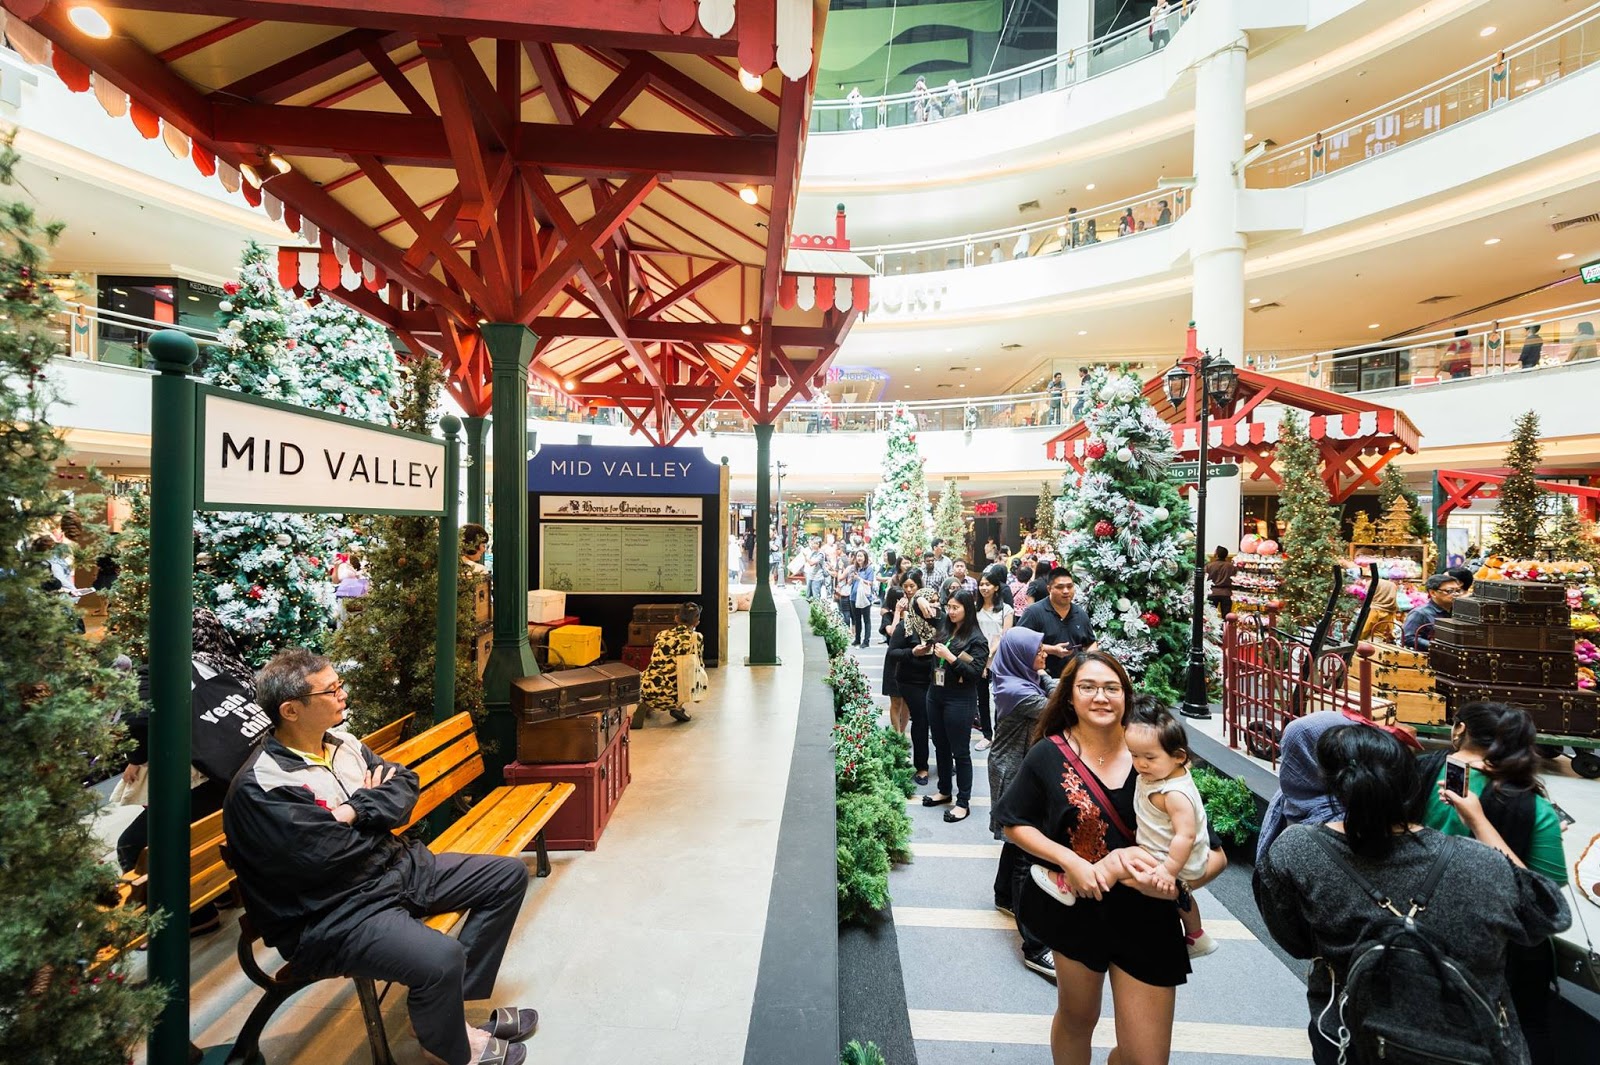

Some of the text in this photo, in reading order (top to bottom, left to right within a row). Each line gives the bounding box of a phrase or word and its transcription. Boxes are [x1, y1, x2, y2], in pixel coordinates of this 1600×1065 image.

[189, 282, 207, 291] KEDAI
[221, 432, 438, 489] MID VALLEY
[551, 460, 692, 478] MID VALLEY
[582, 500, 661, 514] Home for Christmas
[200, 694, 247, 724] Yeah
